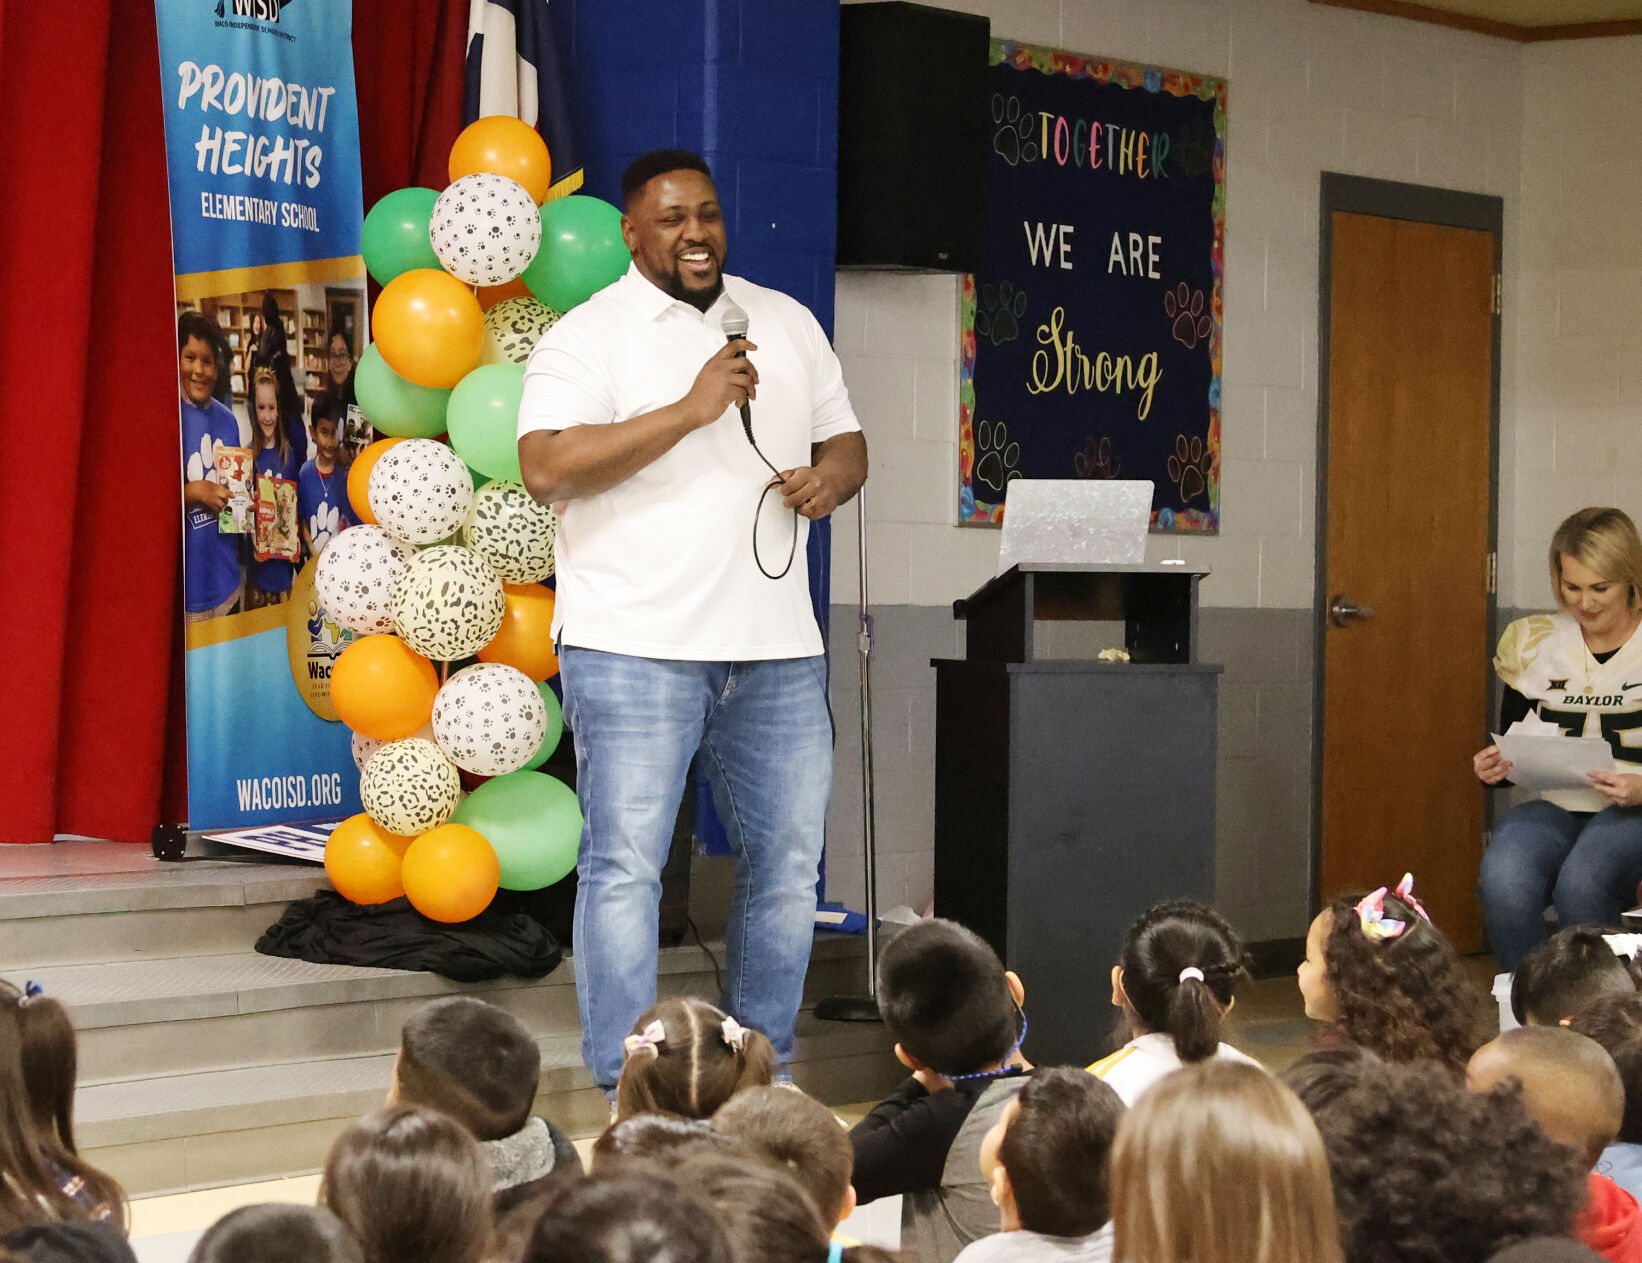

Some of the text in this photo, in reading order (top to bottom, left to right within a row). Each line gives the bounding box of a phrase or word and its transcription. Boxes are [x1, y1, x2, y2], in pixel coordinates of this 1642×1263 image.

[177, 61, 336, 133] PROVIDENT
[195, 123, 323, 189] HEIGHTS
[1038, 111, 1170, 179] TOGETHER
[201, 192, 320, 233] ELEMENTARY SCHOOL
[1023, 221, 1162, 280] WE ARE
[1026, 306, 1163, 421] Strong
[307, 661, 334, 679] Wac
[1562, 695, 1624, 706] BAYLOR
[236, 772, 342, 812] WACOISD.ORG
